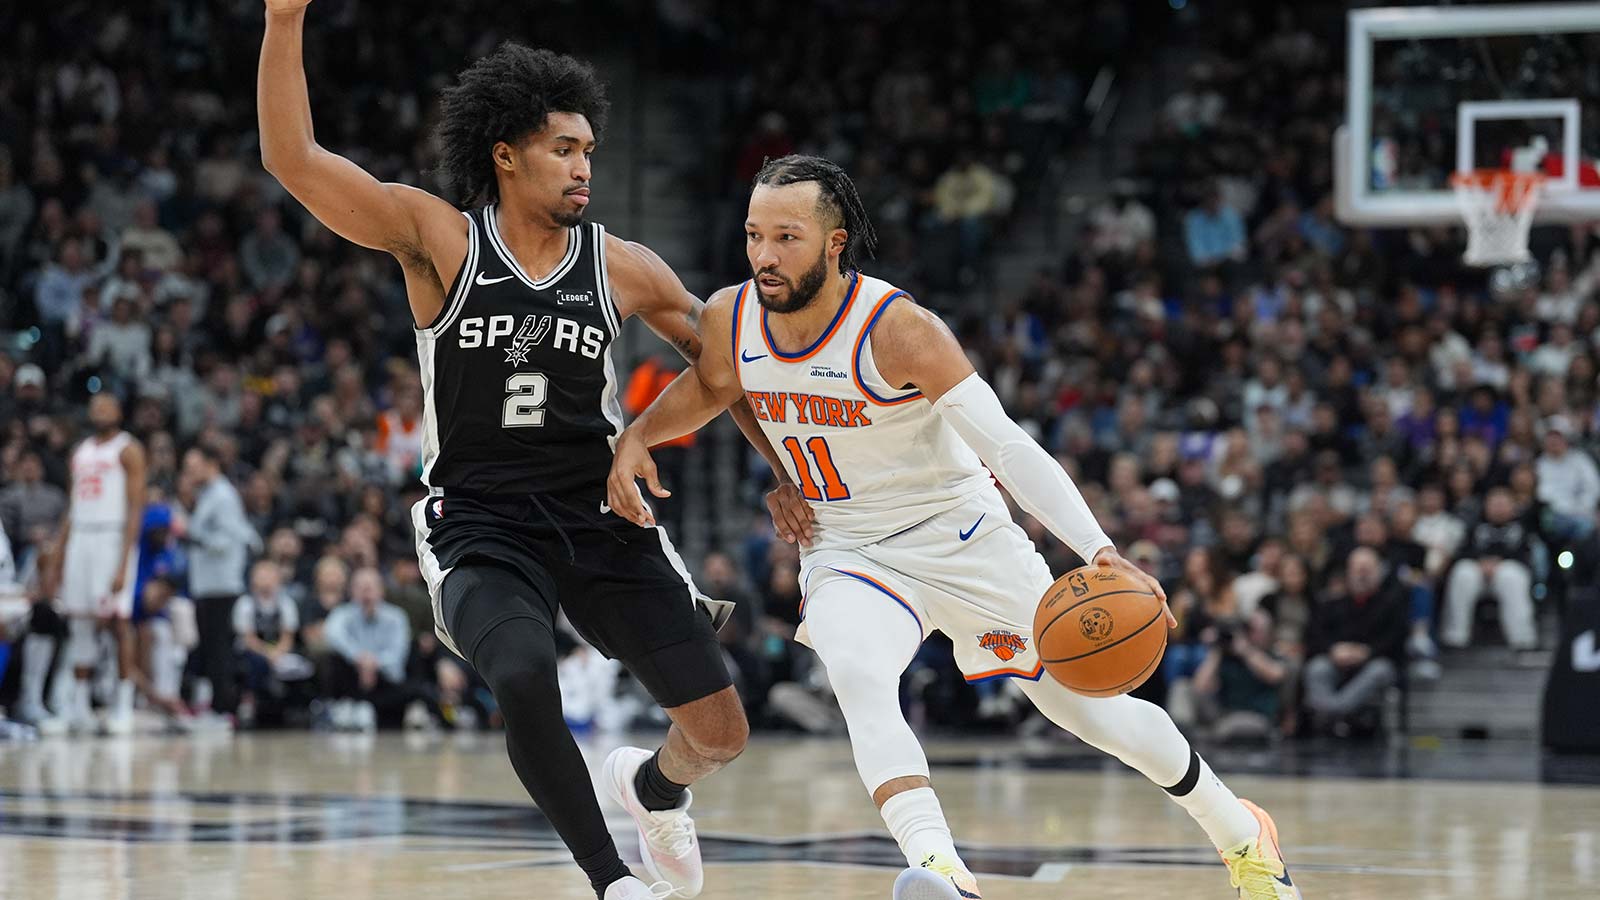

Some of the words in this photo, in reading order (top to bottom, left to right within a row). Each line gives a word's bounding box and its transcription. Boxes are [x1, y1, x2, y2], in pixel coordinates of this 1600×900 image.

[561, 293, 589, 302] LEDGER
[458, 314, 605, 368] SPURS
[810, 369, 825, 377] abu
[825, 370, 848, 379] dhabi
[501, 372, 549, 429] 2
[789, 392, 873, 428] YORK
[781, 436, 852, 502] 11
[979, 632, 1027, 651] KNICKS
